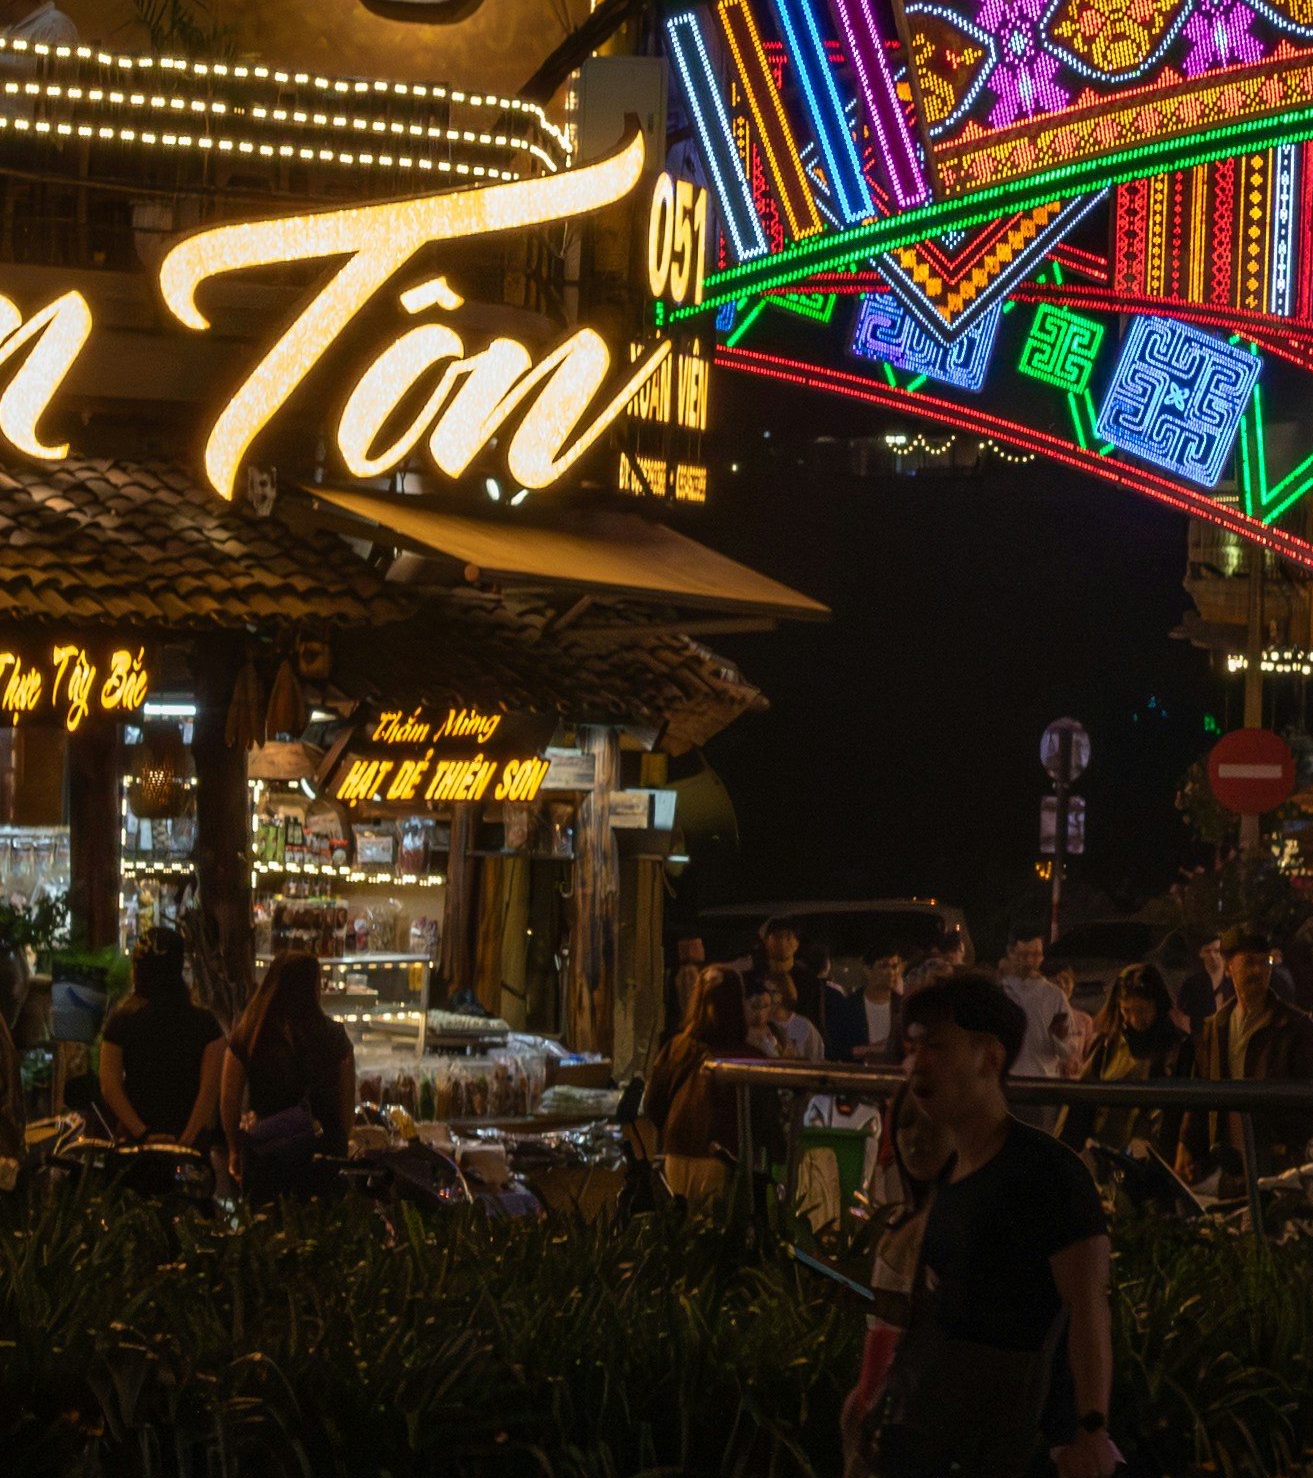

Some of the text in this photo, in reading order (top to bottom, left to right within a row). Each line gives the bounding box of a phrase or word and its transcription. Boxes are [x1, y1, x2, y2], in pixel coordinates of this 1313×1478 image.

[649, 171, 708, 306] 051
[160, 129, 672, 502] Tôn
[52, 644, 97, 732] Tây
[336, 759, 395, 808] HẠT
[424, 752, 498, 801] THIÊN
[494, 755, 550, 801] SƠN
